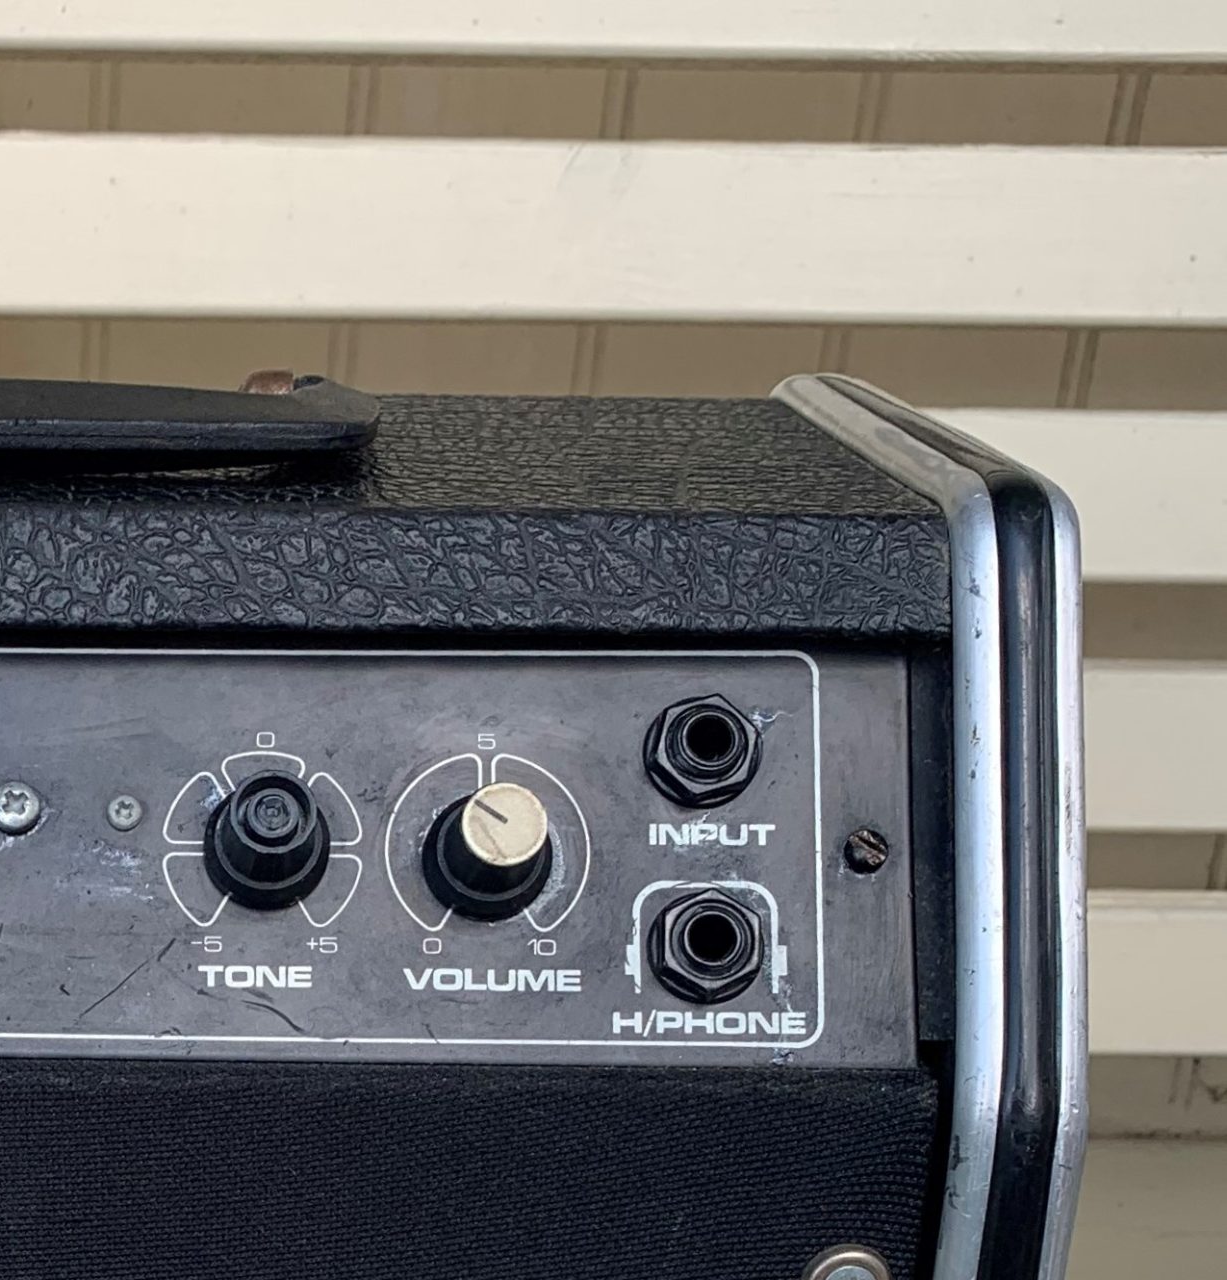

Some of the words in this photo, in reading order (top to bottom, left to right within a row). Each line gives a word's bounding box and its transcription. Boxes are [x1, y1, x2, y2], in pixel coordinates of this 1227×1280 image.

[256, 731, 275, 749] 0
[477, 733, 496, 750] 5
[648, 823, 776, 846] INPUT
[190, 935, 223, 953] -5
[305, 936, 339, 954] +5
[422, 937, 443, 955] 0
[526, 938, 557, 956] 10
[198, 965, 314, 989] TONE
[403, 967, 583, 993] VOLUME
[612, 1009, 808, 1037] H/PHONE
